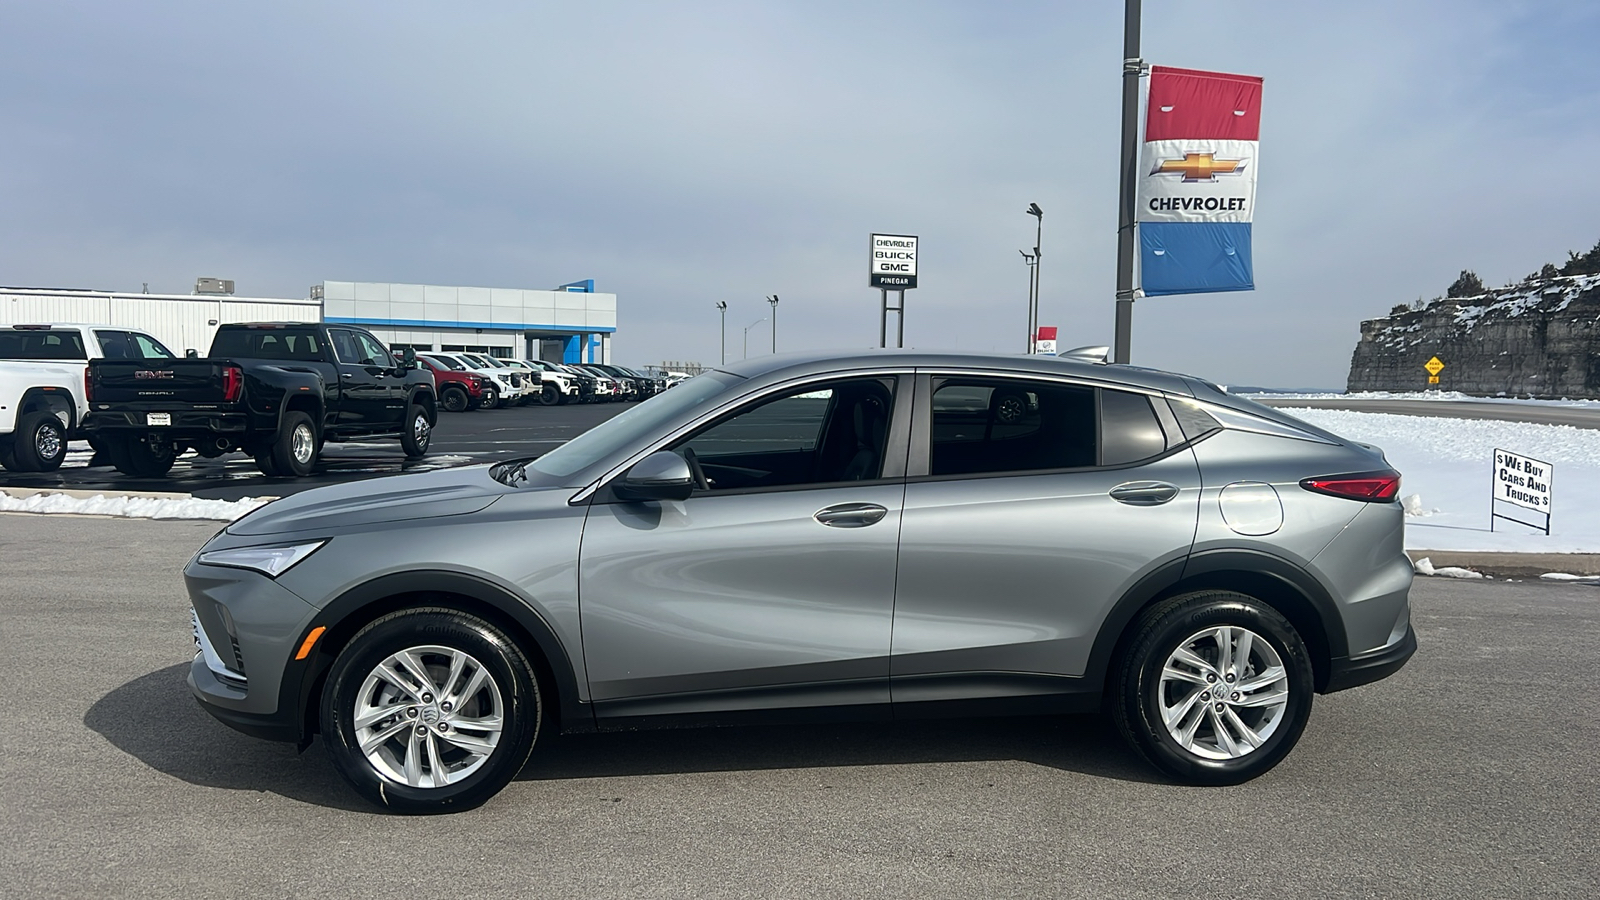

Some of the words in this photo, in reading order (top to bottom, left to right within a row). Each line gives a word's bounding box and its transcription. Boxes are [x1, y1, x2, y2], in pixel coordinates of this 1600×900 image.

[876, 239, 914, 248] CHEVROLET
[875, 251, 914, 260] BUICK
[880, 263, 909, 271] GMC
[880, 277, 909, 285] PINEGAR
[134, 370, 174, 379] GMC
